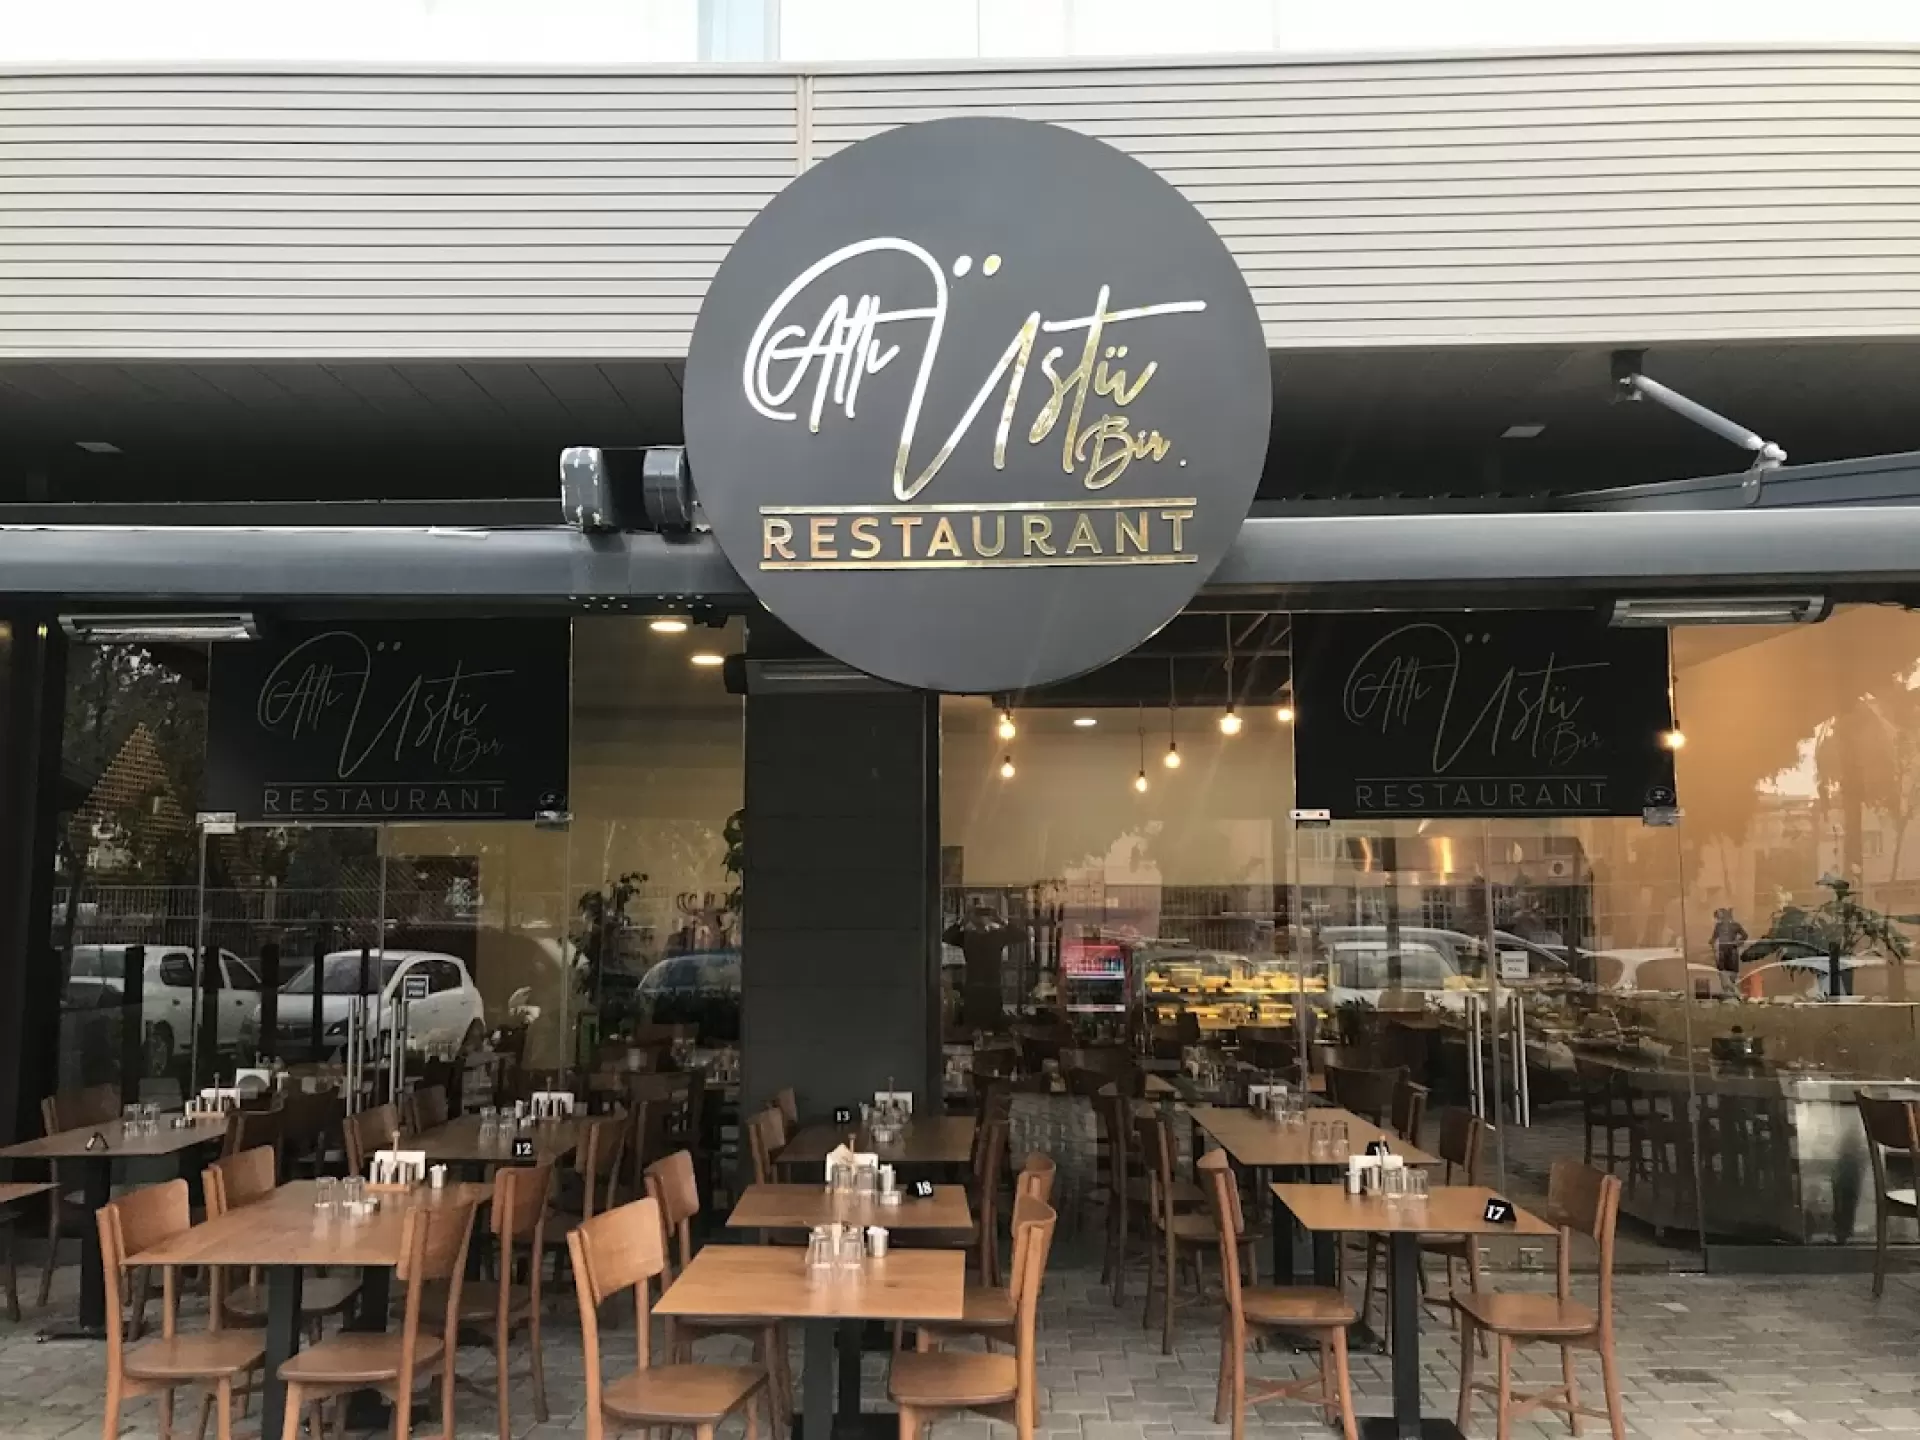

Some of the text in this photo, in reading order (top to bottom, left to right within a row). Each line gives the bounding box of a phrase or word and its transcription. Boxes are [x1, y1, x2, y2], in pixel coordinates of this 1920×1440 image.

[763, 509, 1195, 560] RESTAURANT
[263, 787, 504, 812] RESTAURANT
[1355, 782, 1608, 809] RESTAURANT
[516, 1142, 532, 1155] 12
[916, 1180, 932, 1196] 18
[1486, 1205, 1505, 1220] 17
